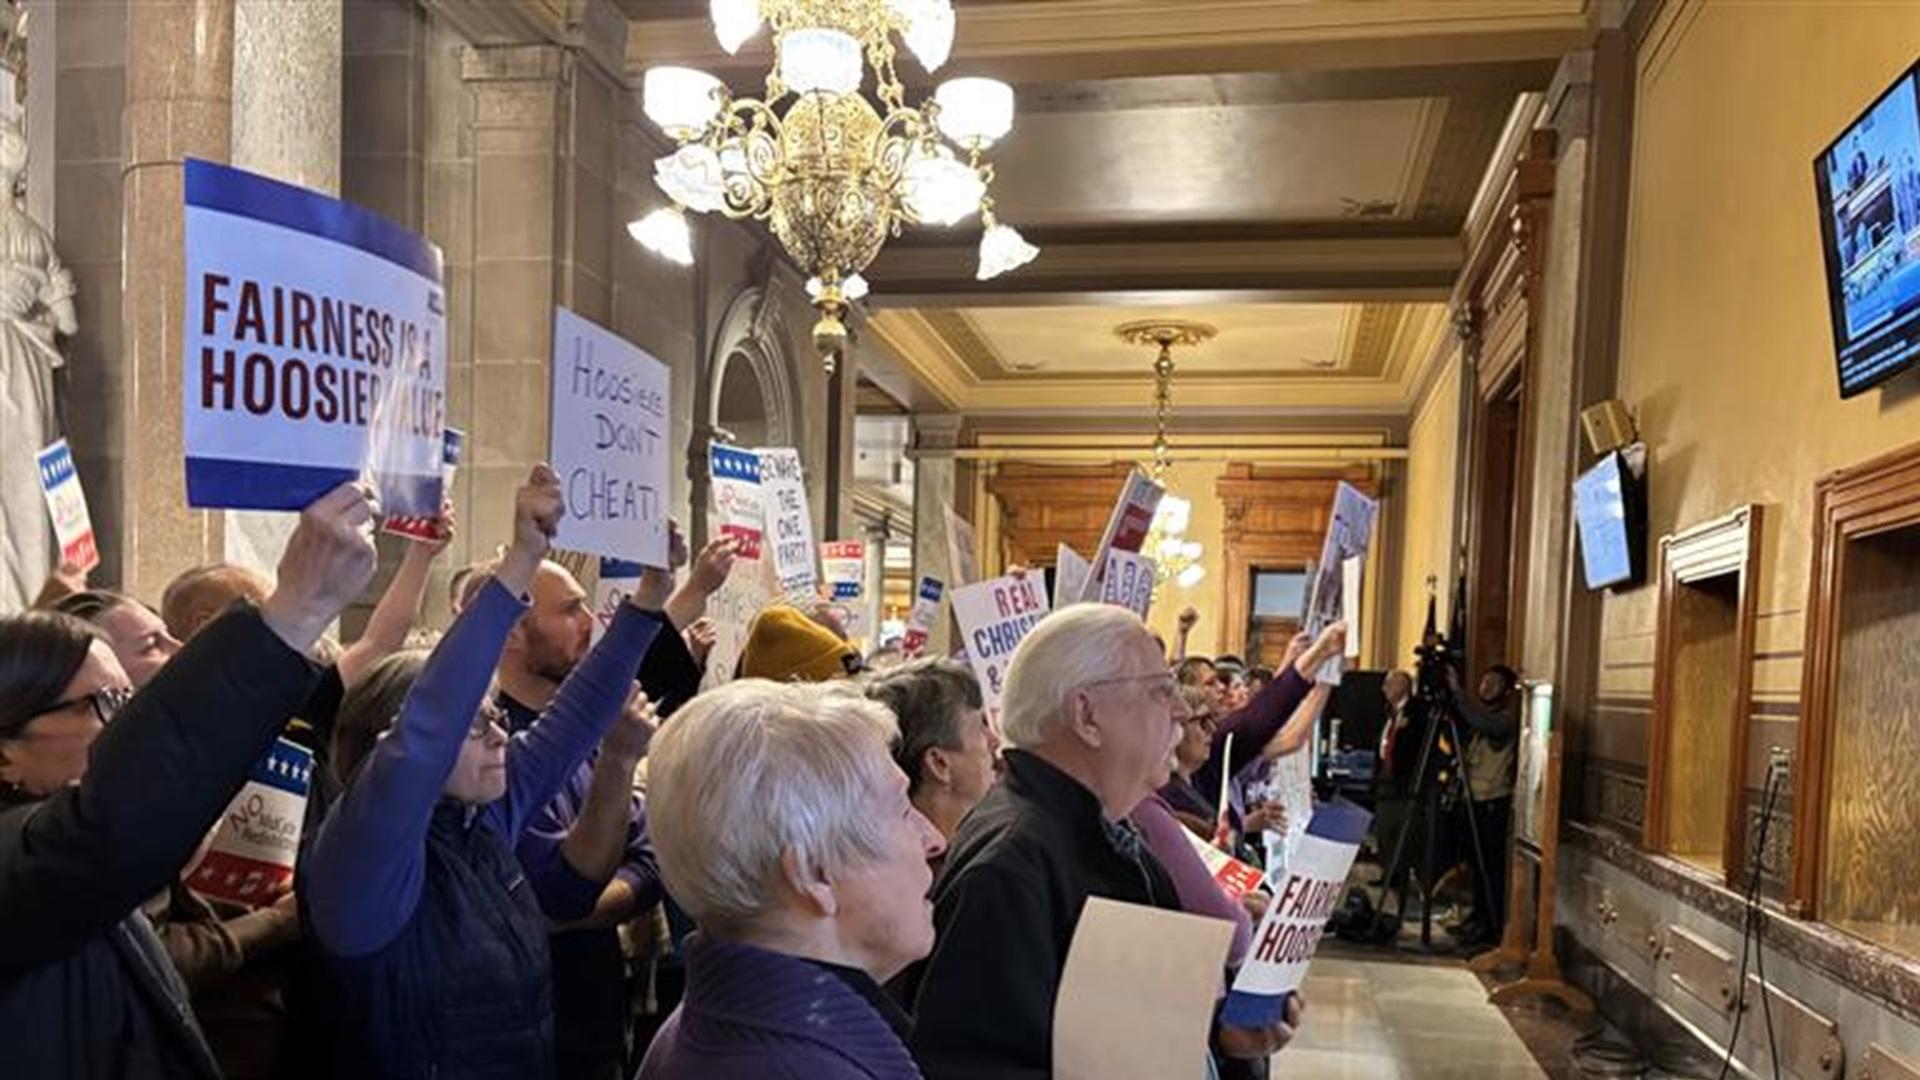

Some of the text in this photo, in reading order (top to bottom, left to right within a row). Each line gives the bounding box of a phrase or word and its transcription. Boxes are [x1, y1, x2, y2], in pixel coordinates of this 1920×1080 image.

[203, 273, 394, 368] FAIRNESS
[994, 582, 1039, 618] REAL
[230, 794, 263, 832] NO
